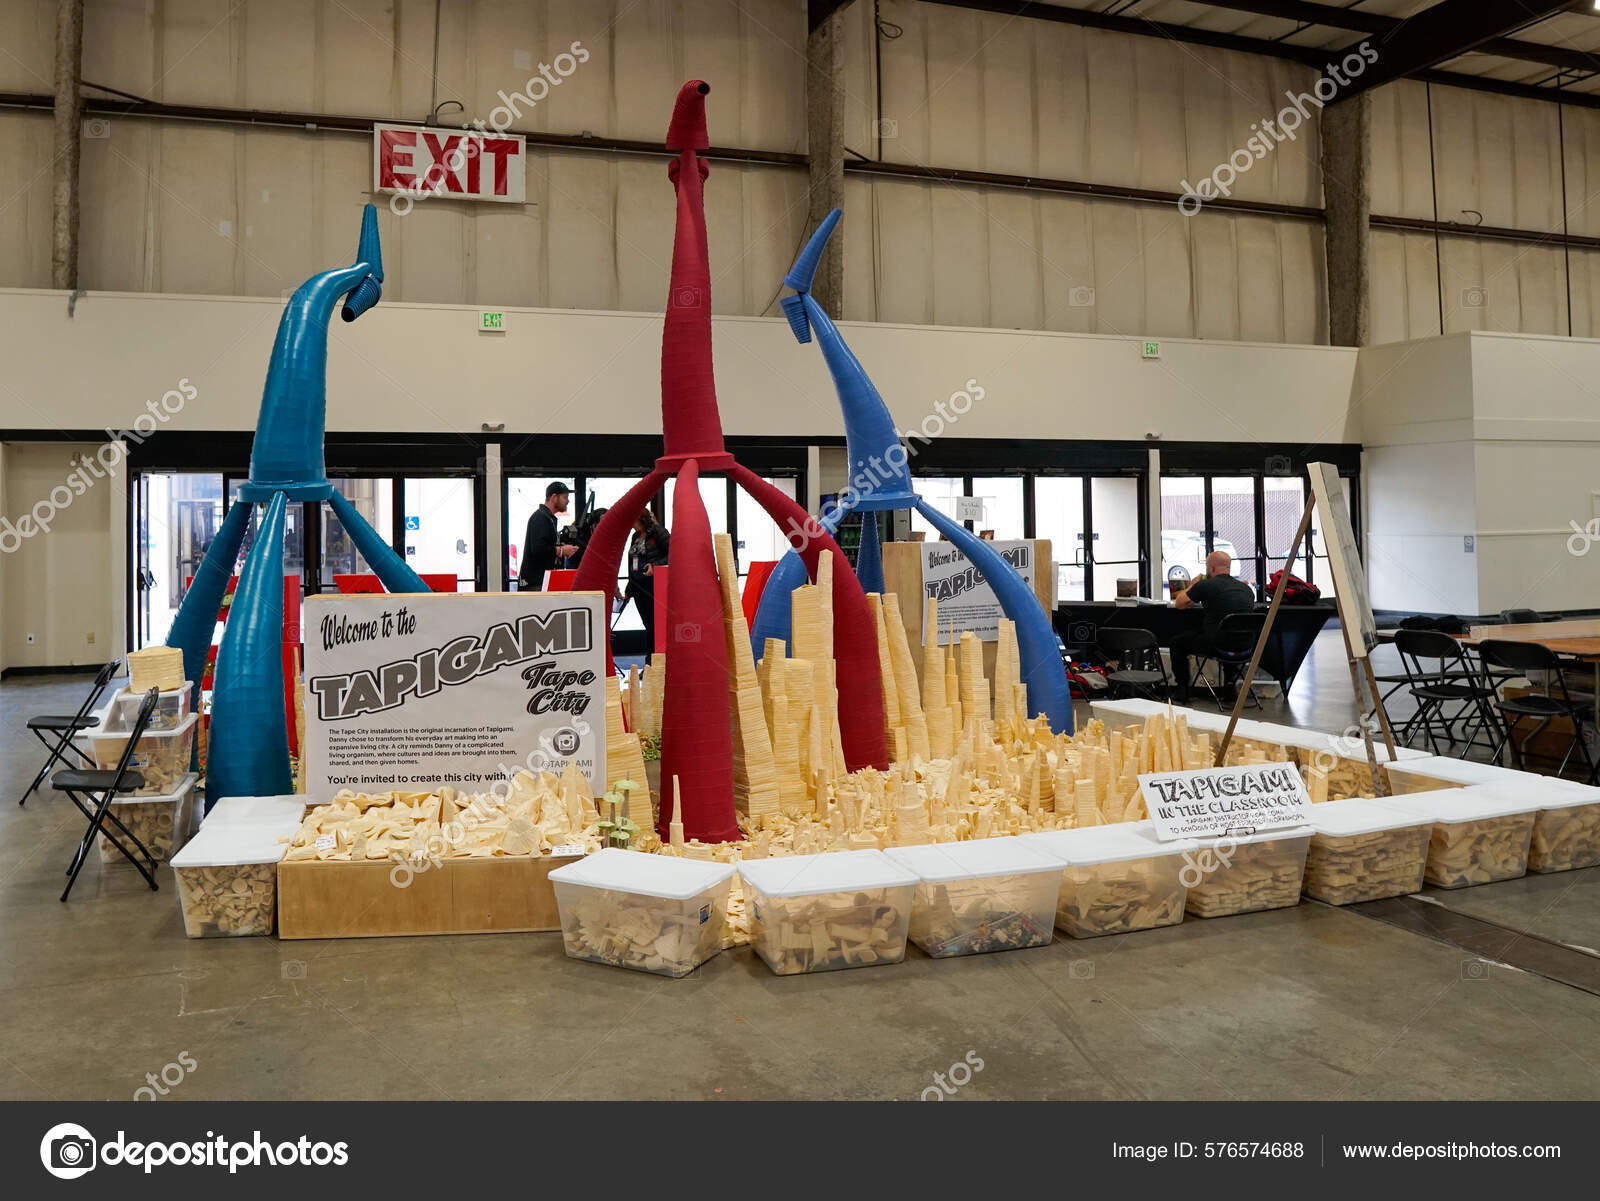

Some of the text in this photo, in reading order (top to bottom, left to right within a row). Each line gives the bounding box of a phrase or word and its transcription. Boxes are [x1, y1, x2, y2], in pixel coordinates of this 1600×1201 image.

[380, 130, 519, 196] EXIT
[483, 312, 503, 328] EXIT
[1145, 342, 1159, 355] EXIT
[929, 551, 951, 569] Welcome
[321, 606, 417, 650] Welcome to the
[310, 607, 592, 721] TAPIGAMI
[521, 661, 597, 691] Tape
[526, 689, 592, 716] City
[541, 760, 592, 768] @TAPIAMI
[328, 775, 358, 784] You're
[361, 774, 395, 783] invited
[398, 774, 408, 783] to
[410, 774, 441, 782] create
[444, 773, 461, 782] this
[464, 772, 482, 782] city
[484, 772, 506, 781] with
[1150, 768, 1296, 803] TAPIGAMI
[1158, 795, 1302, 819] IN THE CLASSROOM
[1181, 824, 1208, 832] SCHOOLS
[1220, 821, 1235, 829] HOST
